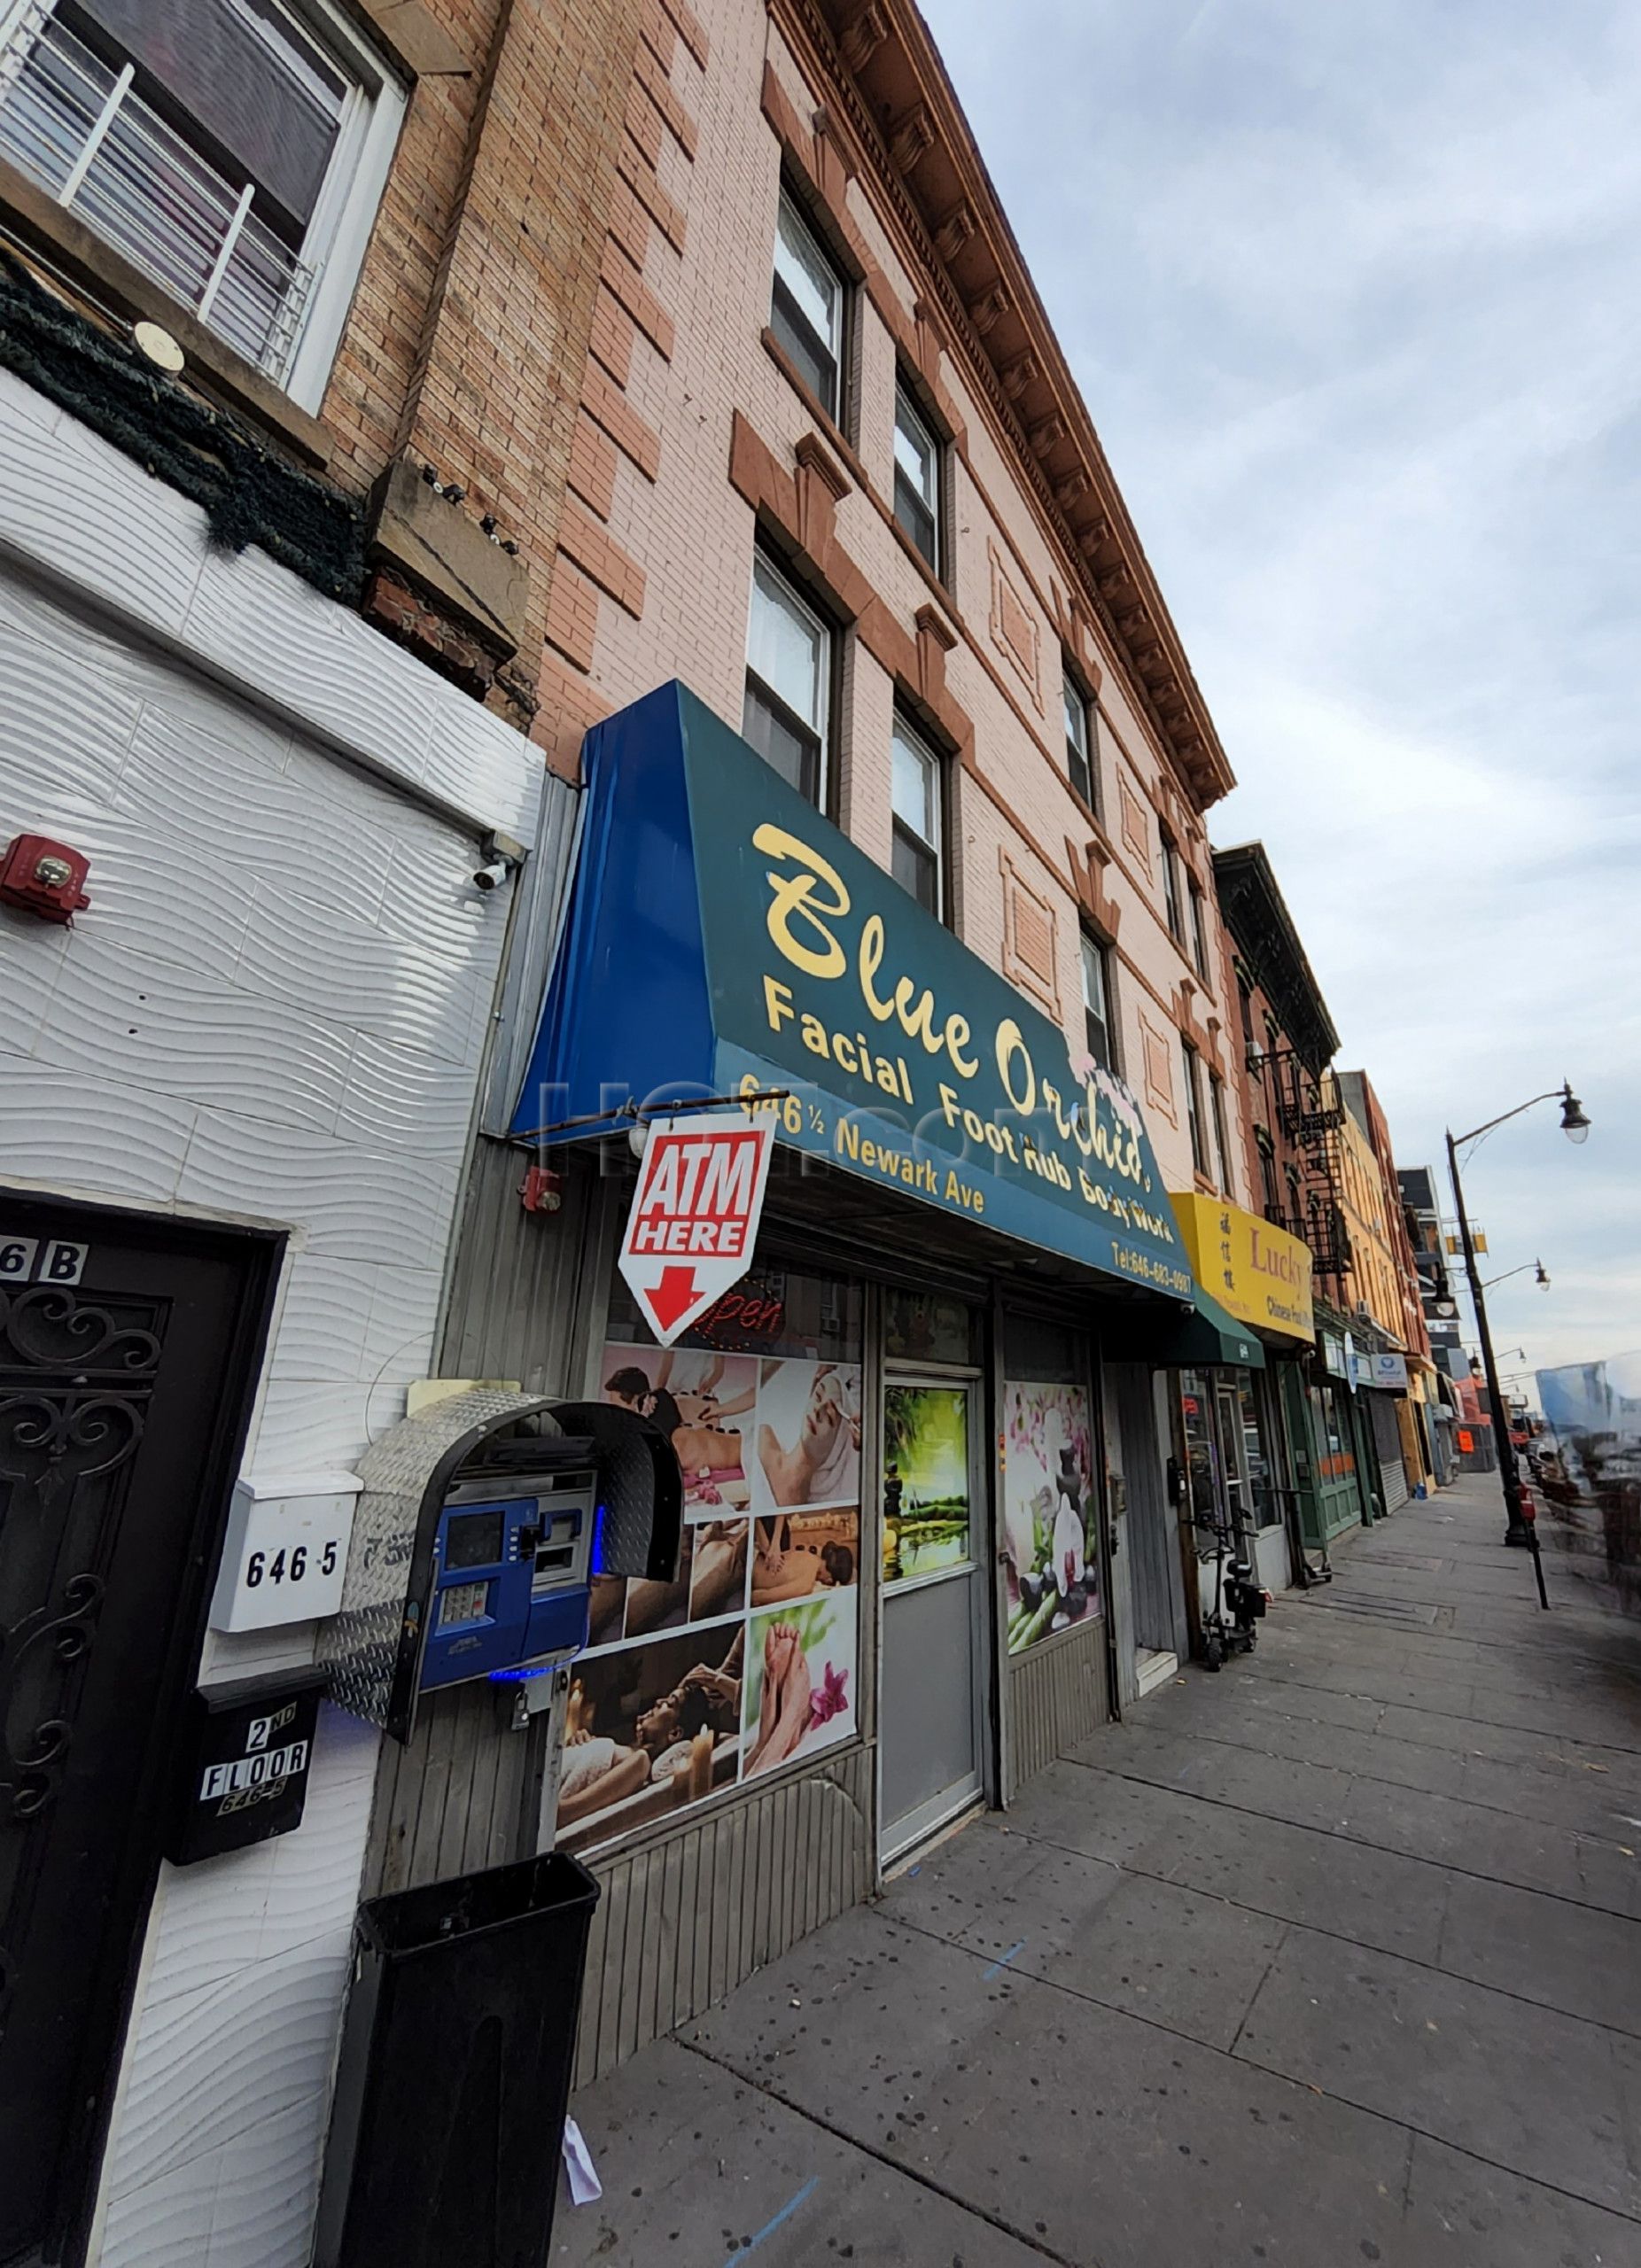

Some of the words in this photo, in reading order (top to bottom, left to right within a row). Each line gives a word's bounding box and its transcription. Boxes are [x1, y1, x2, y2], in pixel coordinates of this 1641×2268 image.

[752, 823, 978, 1078] Blue
[763, 974, 914, 1106] Facial
[939, 1083, 1019, 1164] Foot
[639, 1140, 756, 1217] ATM
[836, 1117, 938, 1195] Newark
[945, 1169, 985, 1215] Ave
[634, 1220, 743, 1253] HERE
[1249, 1226, 1302, 1297] Lucky
[206, 1744, 304, 1798] FLOOR
